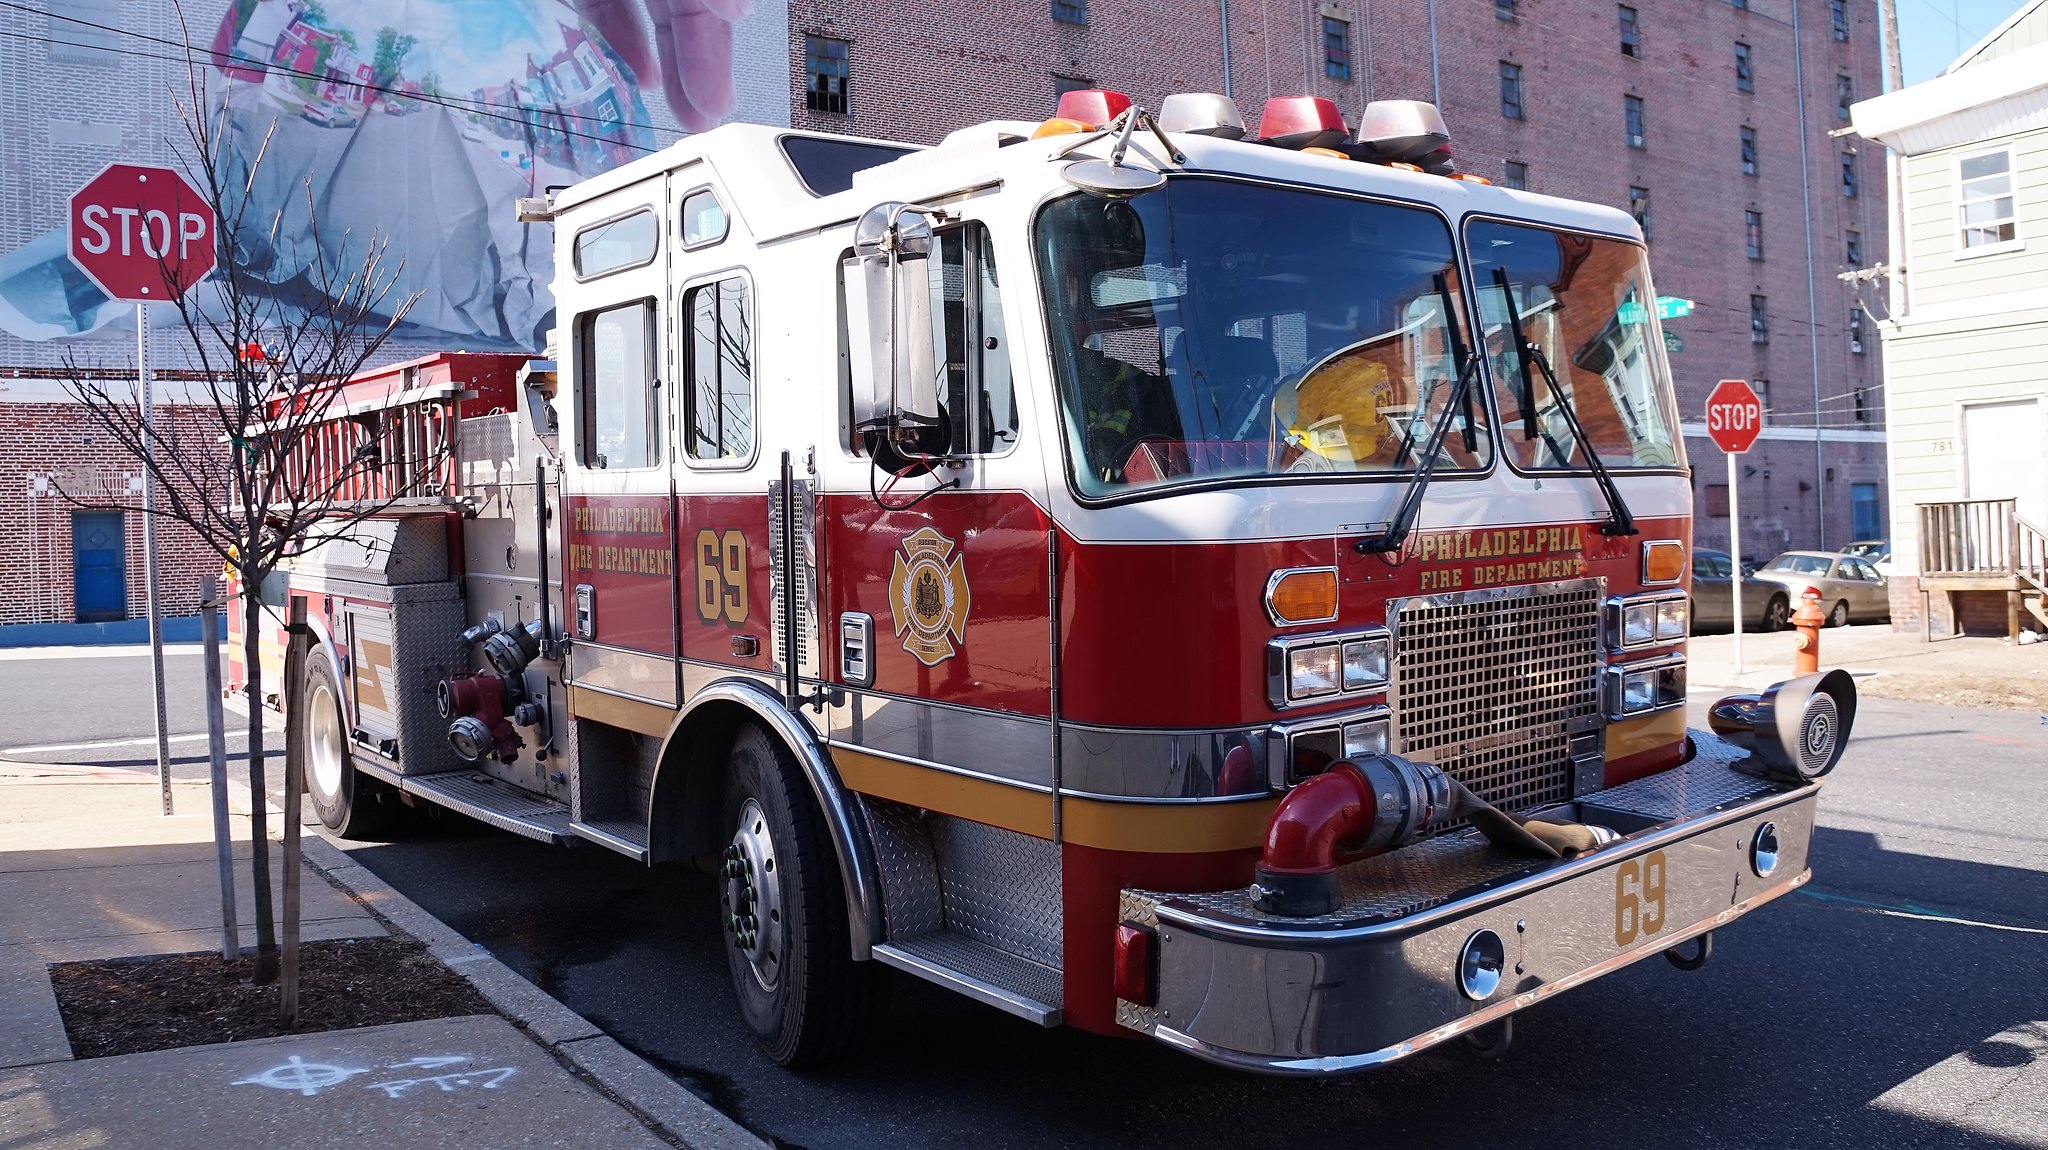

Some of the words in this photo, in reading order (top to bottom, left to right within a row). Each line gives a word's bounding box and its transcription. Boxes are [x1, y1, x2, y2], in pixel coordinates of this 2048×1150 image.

[81, 204, 206, 259] STOP
[1711, 403, 1758, 431] STOP
[1932, 440, 1953, 453] 781
[575, 507, 664, 534] PHILADELPHIA
[1421, 527, 1583, 562] PHILADELPHIA
[598, 546, 672, 576] DEPARTMENT
[911, 552, 946, 569] PHILADELPHIA
[1420, 568, 1462, 590] FIRE
[1474, 558, 1584, 585] DEPARTMENT
[696, 529, 749, 627] 69
[919, 619, 949, 639] DEPARTMENT
[1615, 850, 1666, 947] 69
